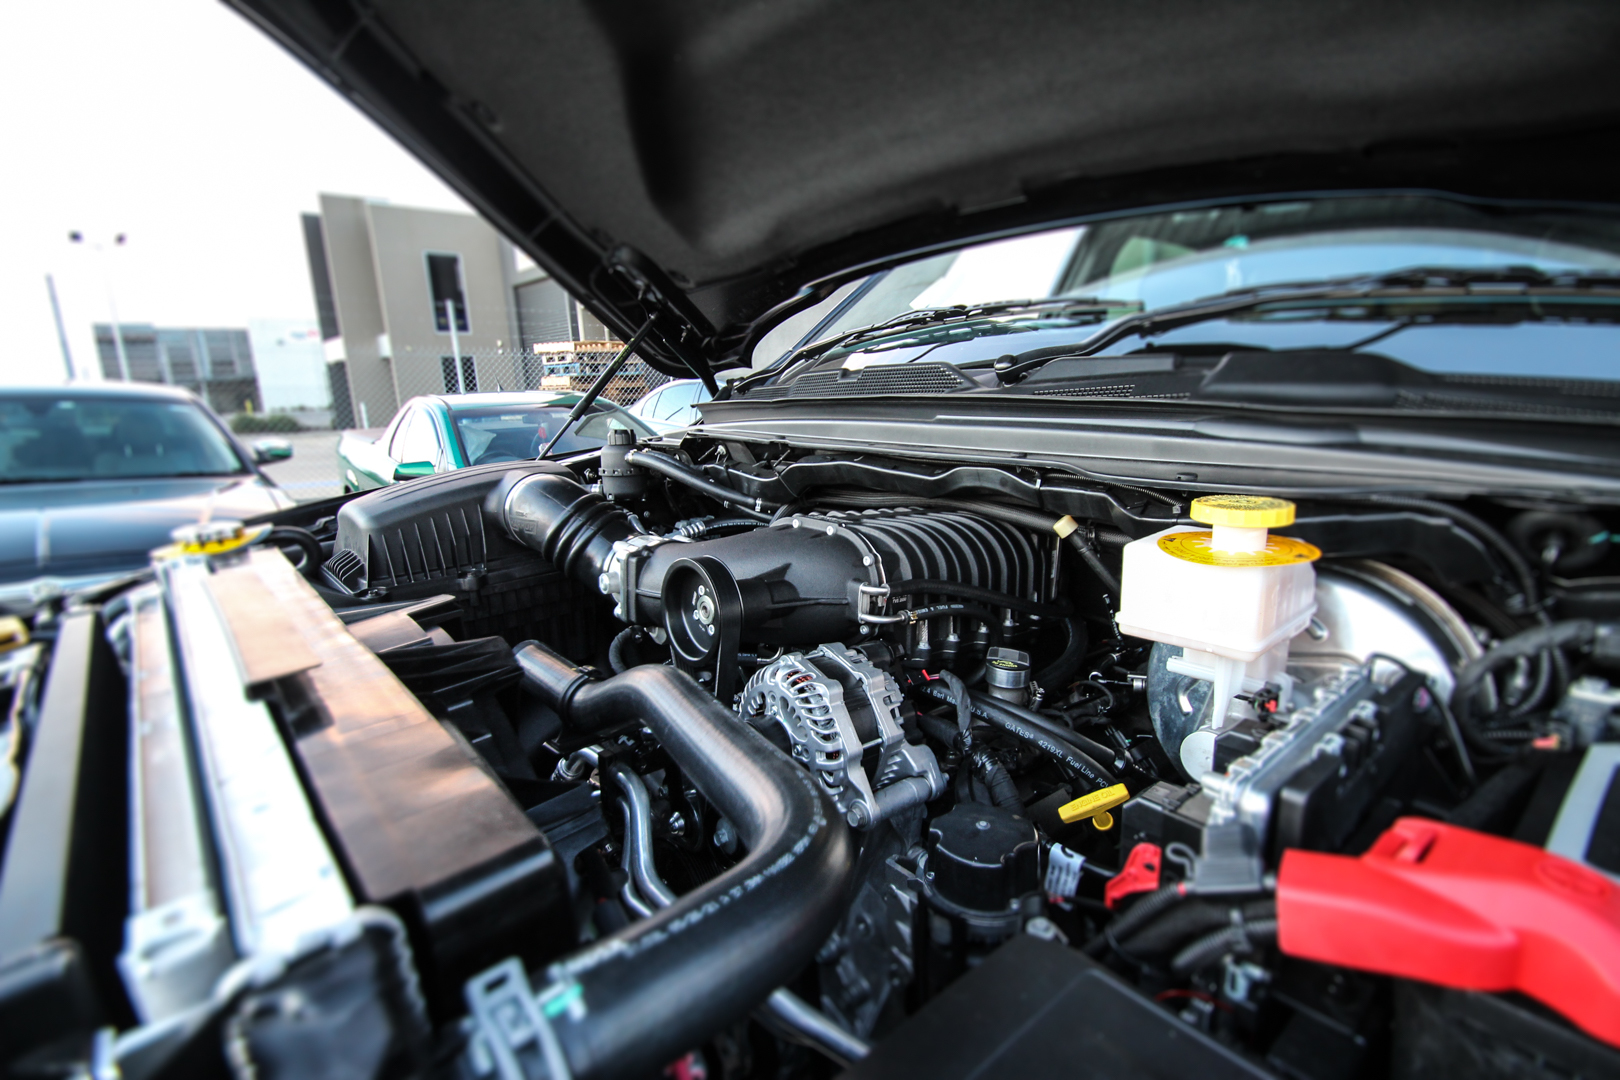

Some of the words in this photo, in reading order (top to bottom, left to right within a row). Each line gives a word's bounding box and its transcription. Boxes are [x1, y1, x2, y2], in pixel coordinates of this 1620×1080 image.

[1038, 740, 1063, 758] 4219XL
[1065, 756, 1082, 770] Fuel
[1080, 765, 1095, 779] Line
[1071, 795, 1101, 811] ENGINE
[1101, 789, 1115, 799] OIL
